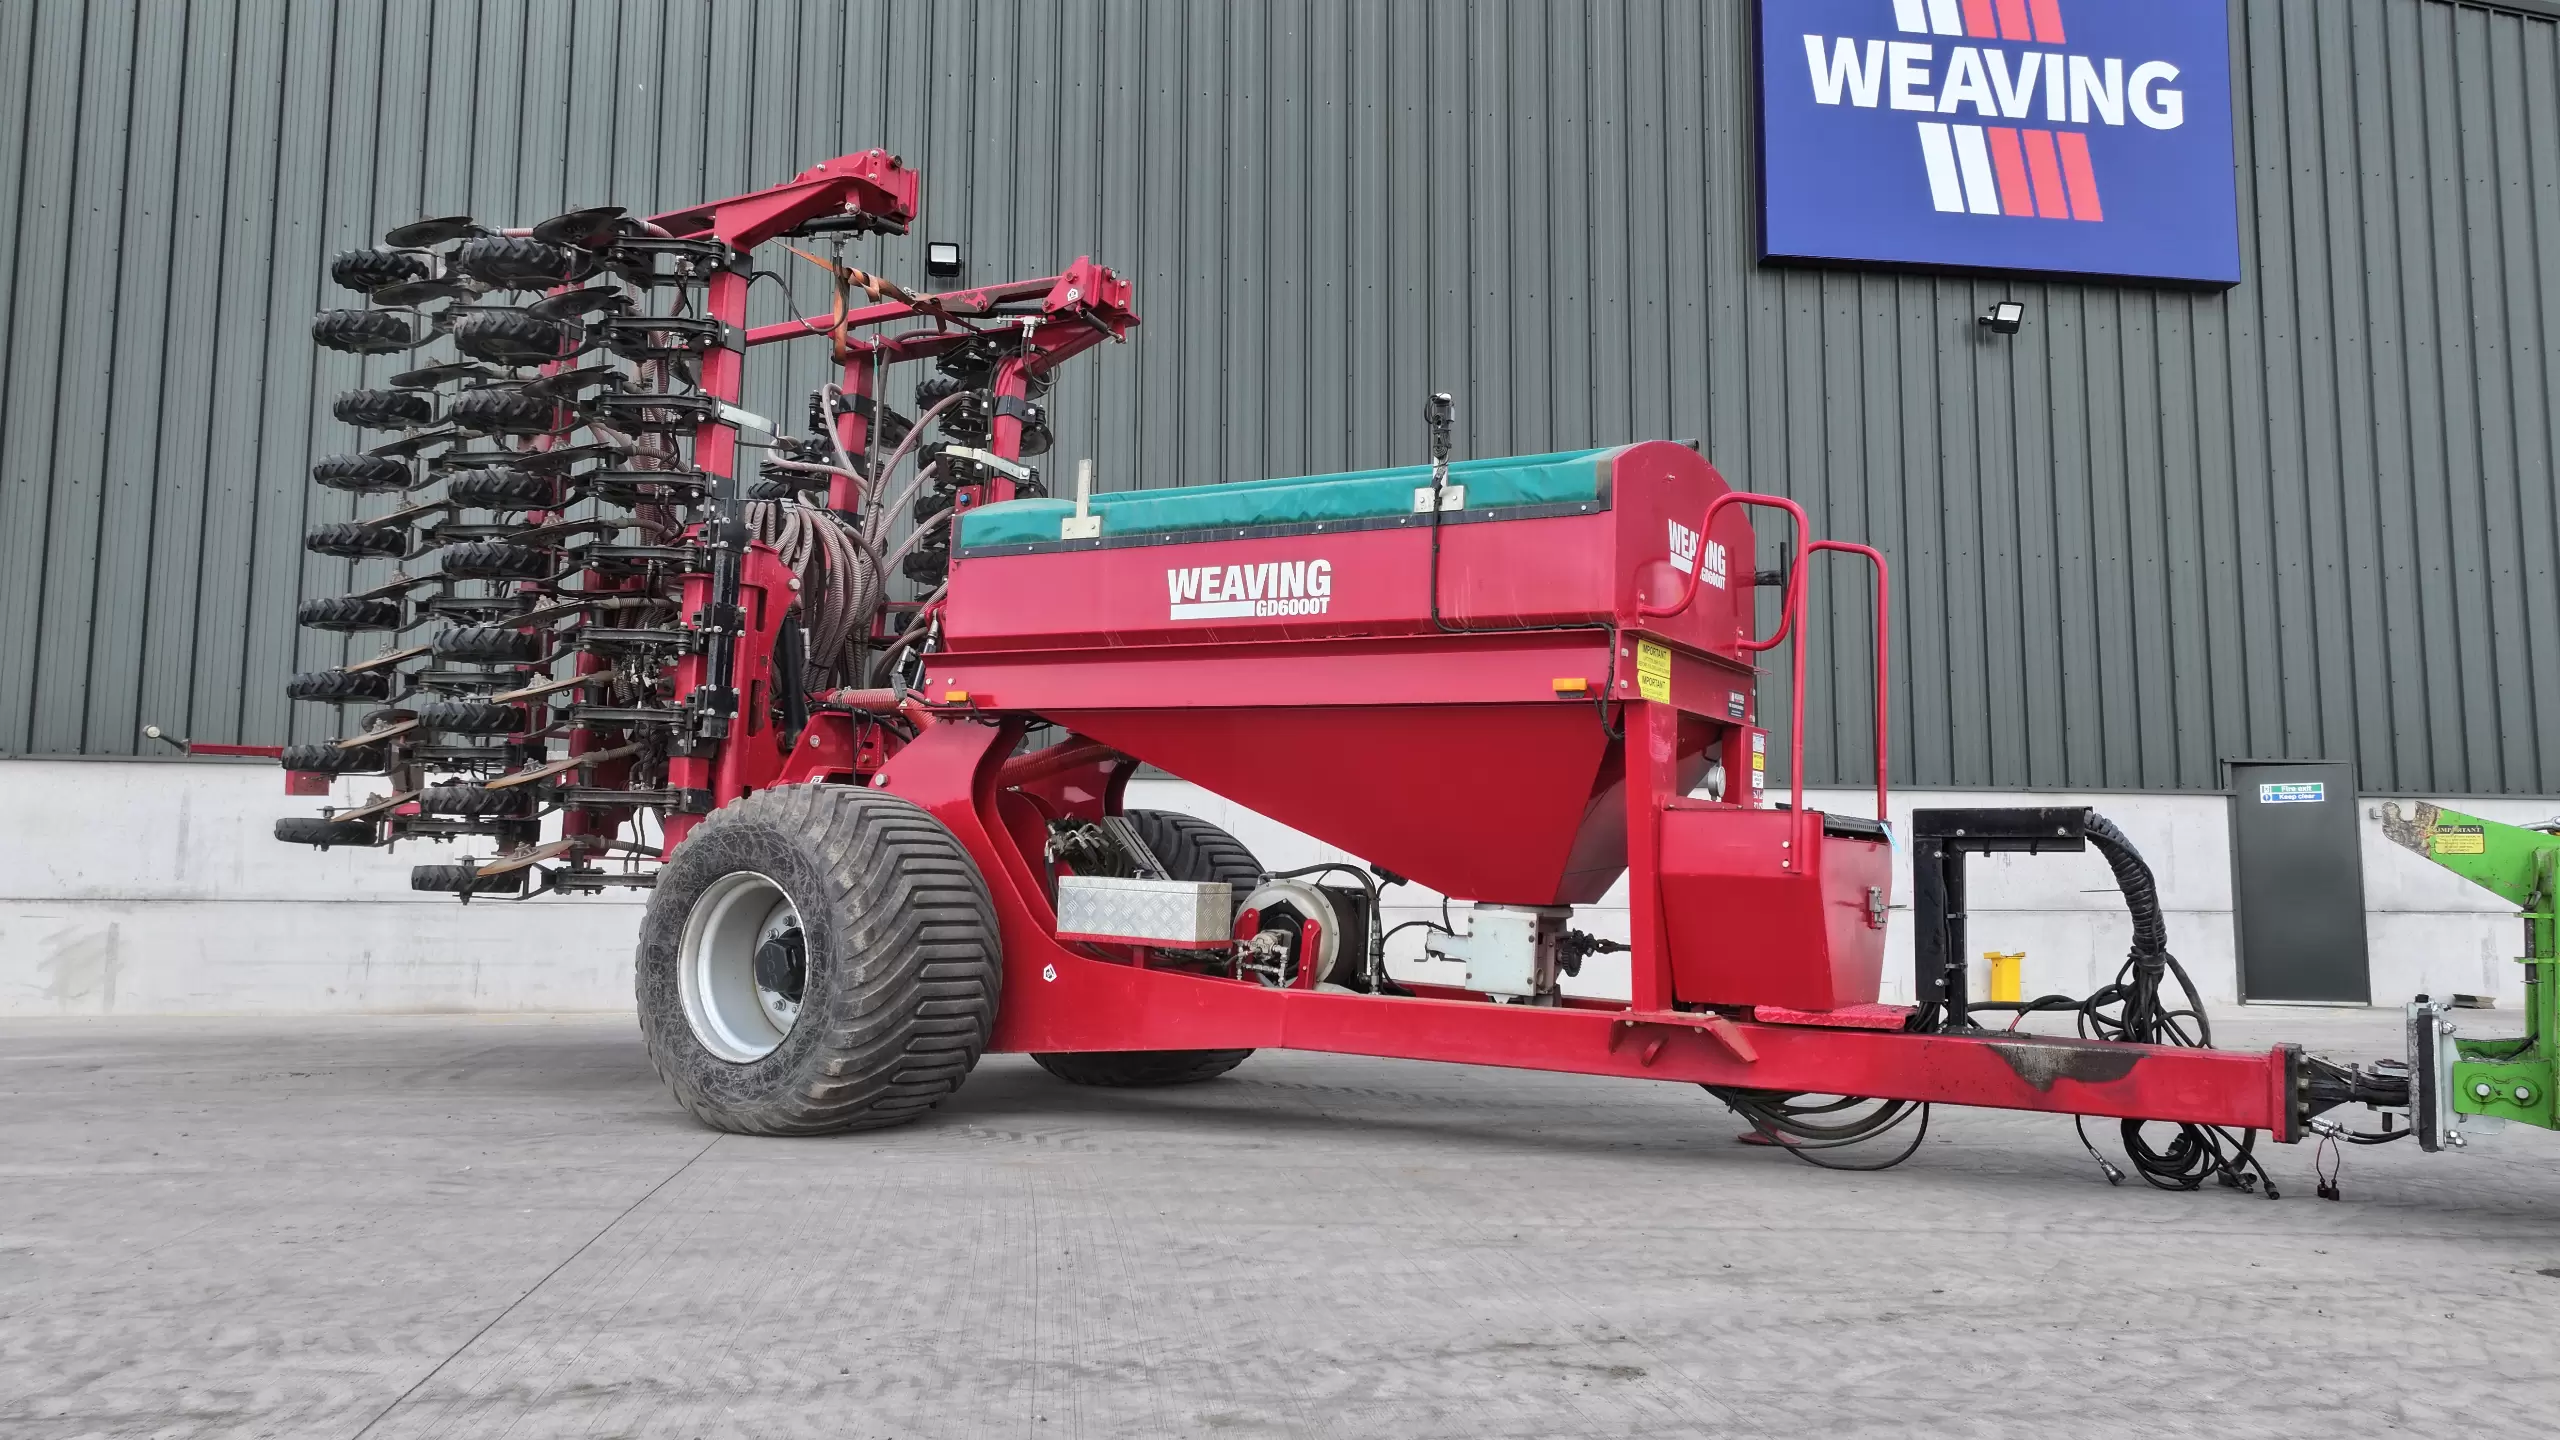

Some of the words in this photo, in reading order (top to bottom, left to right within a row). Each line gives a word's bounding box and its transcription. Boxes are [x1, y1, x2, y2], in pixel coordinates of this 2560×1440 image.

[1803, 34, 2184, 131] WEAVING
[1167, 559, 1332, 604] WEAVING
[1256, 597, 1330, 617] GD6000T
[1642, 644, 1667, 660] IMPORTANT
[1642, 675, 1667, 689] IMPORTANT
